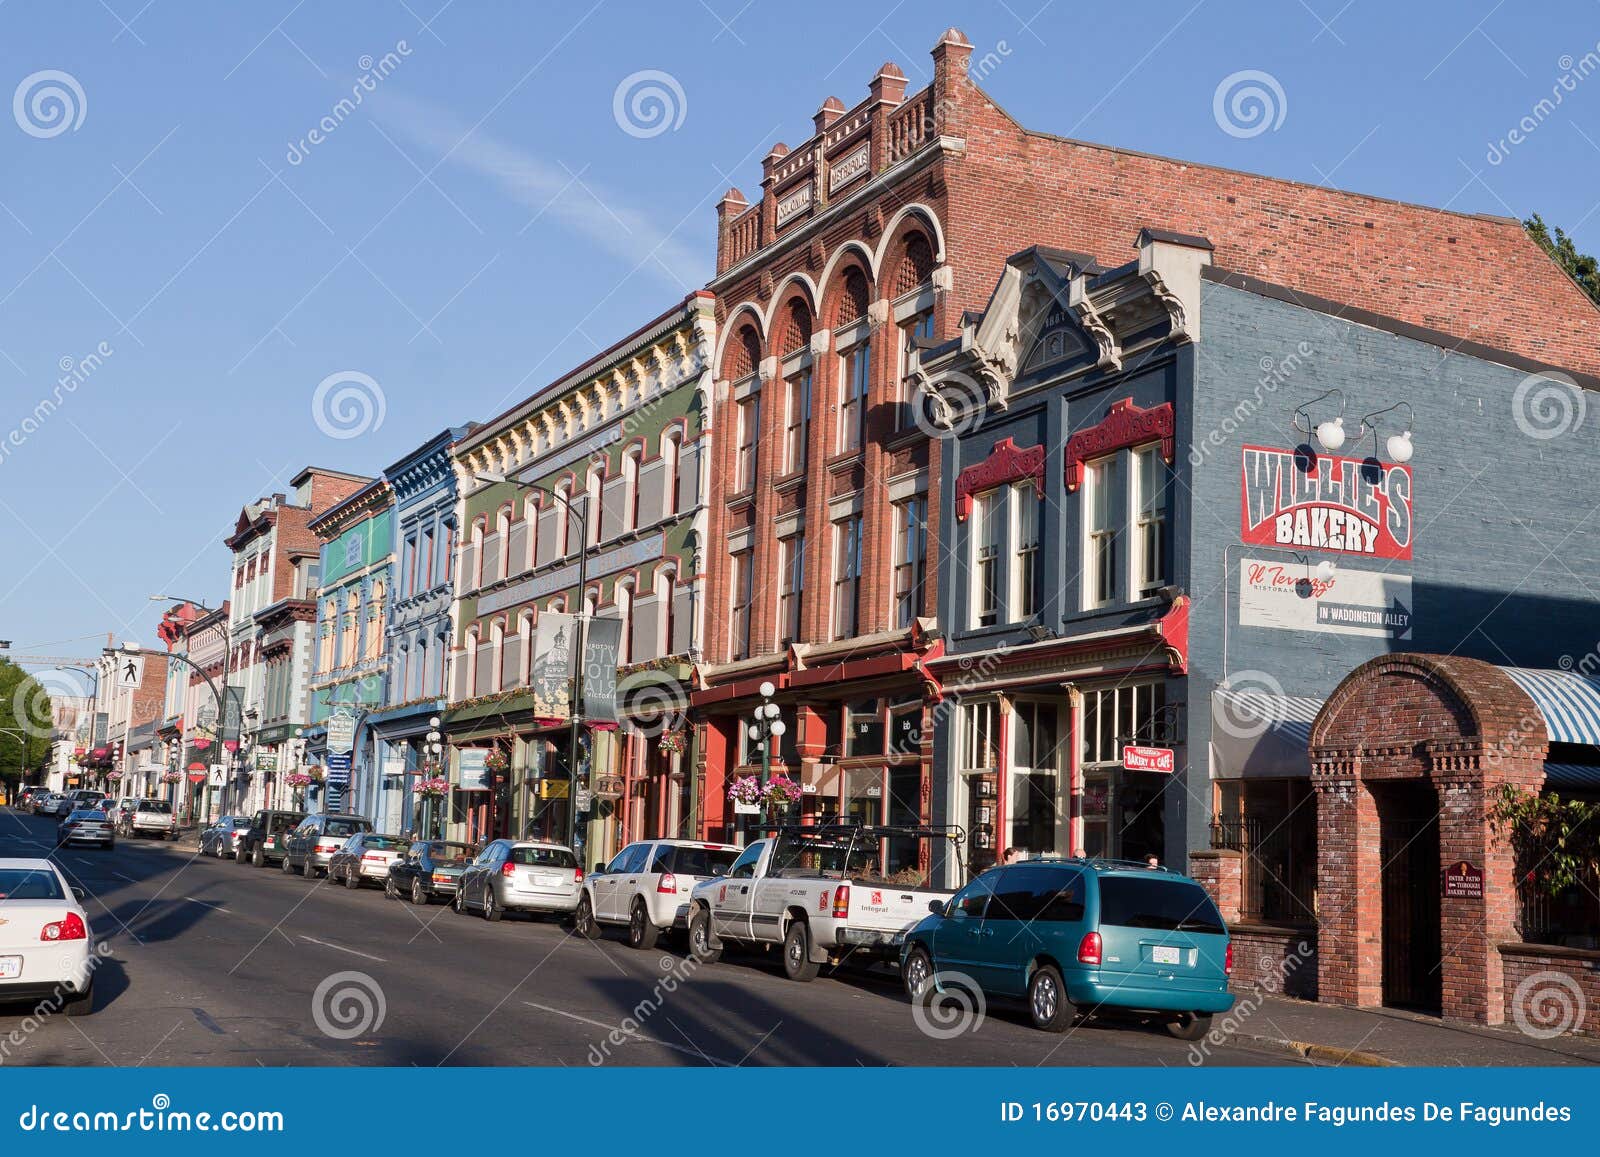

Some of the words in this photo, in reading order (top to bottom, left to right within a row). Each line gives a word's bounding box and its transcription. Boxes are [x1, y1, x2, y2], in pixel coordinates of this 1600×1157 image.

[1243, 448, 1411, 548] WILLIE'S
[1275, 506, 1379, 554] BAKERY
[1253, 584, 1306, 595] RISTORAN
[1319, 606, 1328, 619] IN
[1331, 607, 1382, 625] WADDINGTON
[1384, 612, 1409, 627] ALLEY
[1127, 751, 1148, 766] BAKERY
[802, 783, 817, 793] lab
[861, 904, 889, 914] Integral
